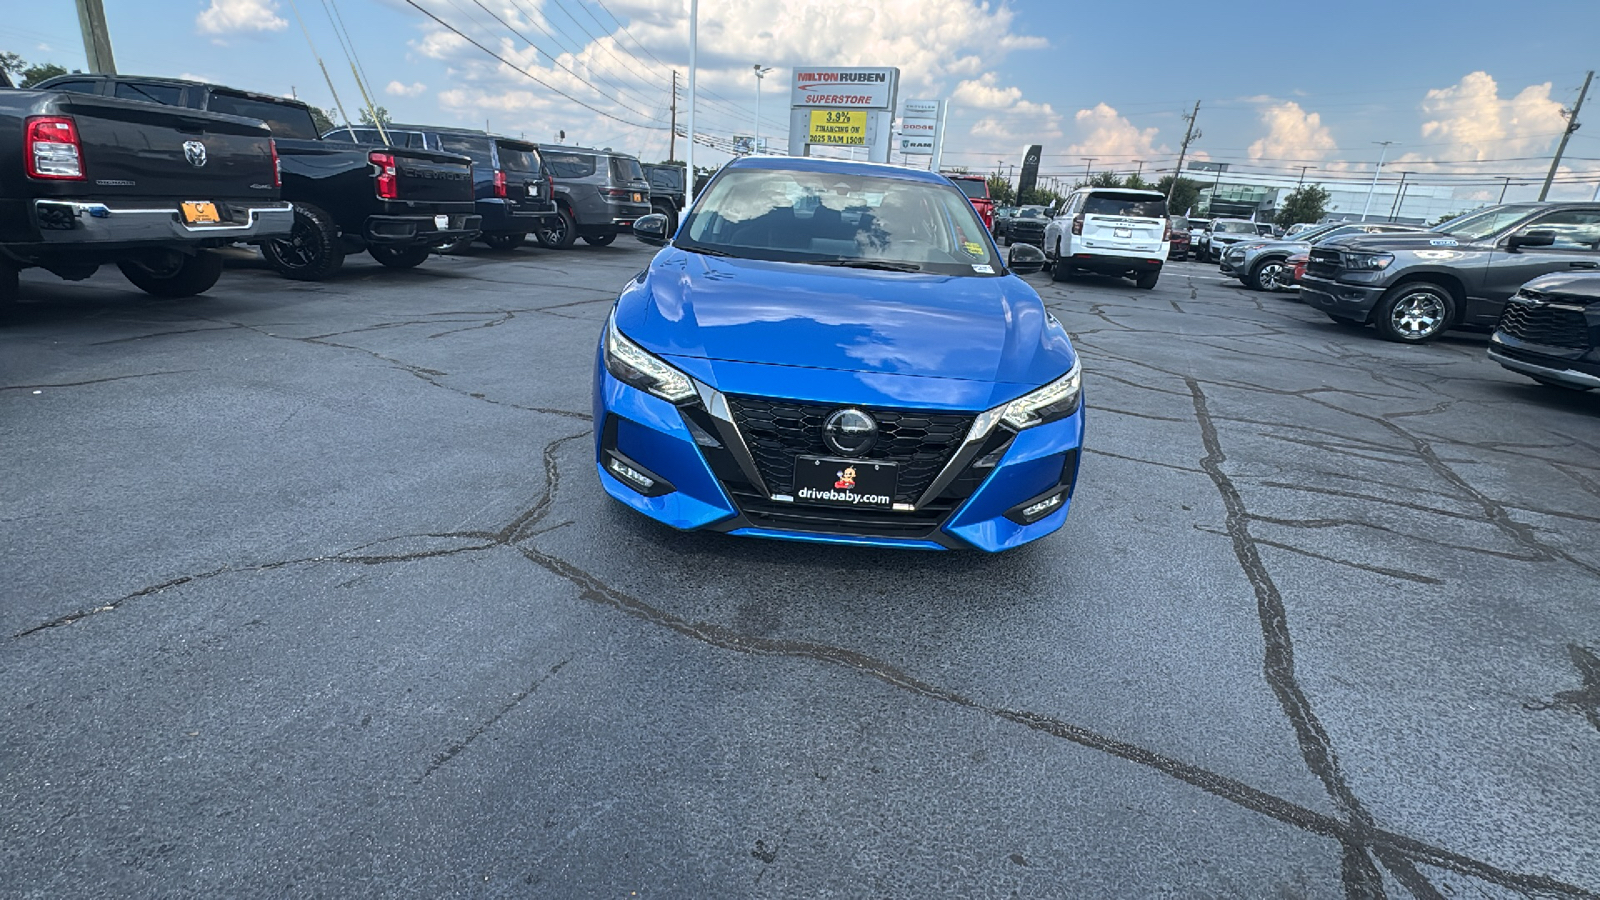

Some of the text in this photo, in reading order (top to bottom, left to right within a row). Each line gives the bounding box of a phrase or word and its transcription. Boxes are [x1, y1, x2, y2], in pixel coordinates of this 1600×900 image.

[797, 72, 886, 83] MILTON RUBEN
[805, 94, 873, 104] SUPERSTORE
[826, 111, 851, 123] 3.9%
[815, 124, 861, 134] FINANCING ON
[809, 134, 826, 143] 2025
[826, 135, 844, 144] RAM
[798, 486, 890, 504] drivebaby.com
